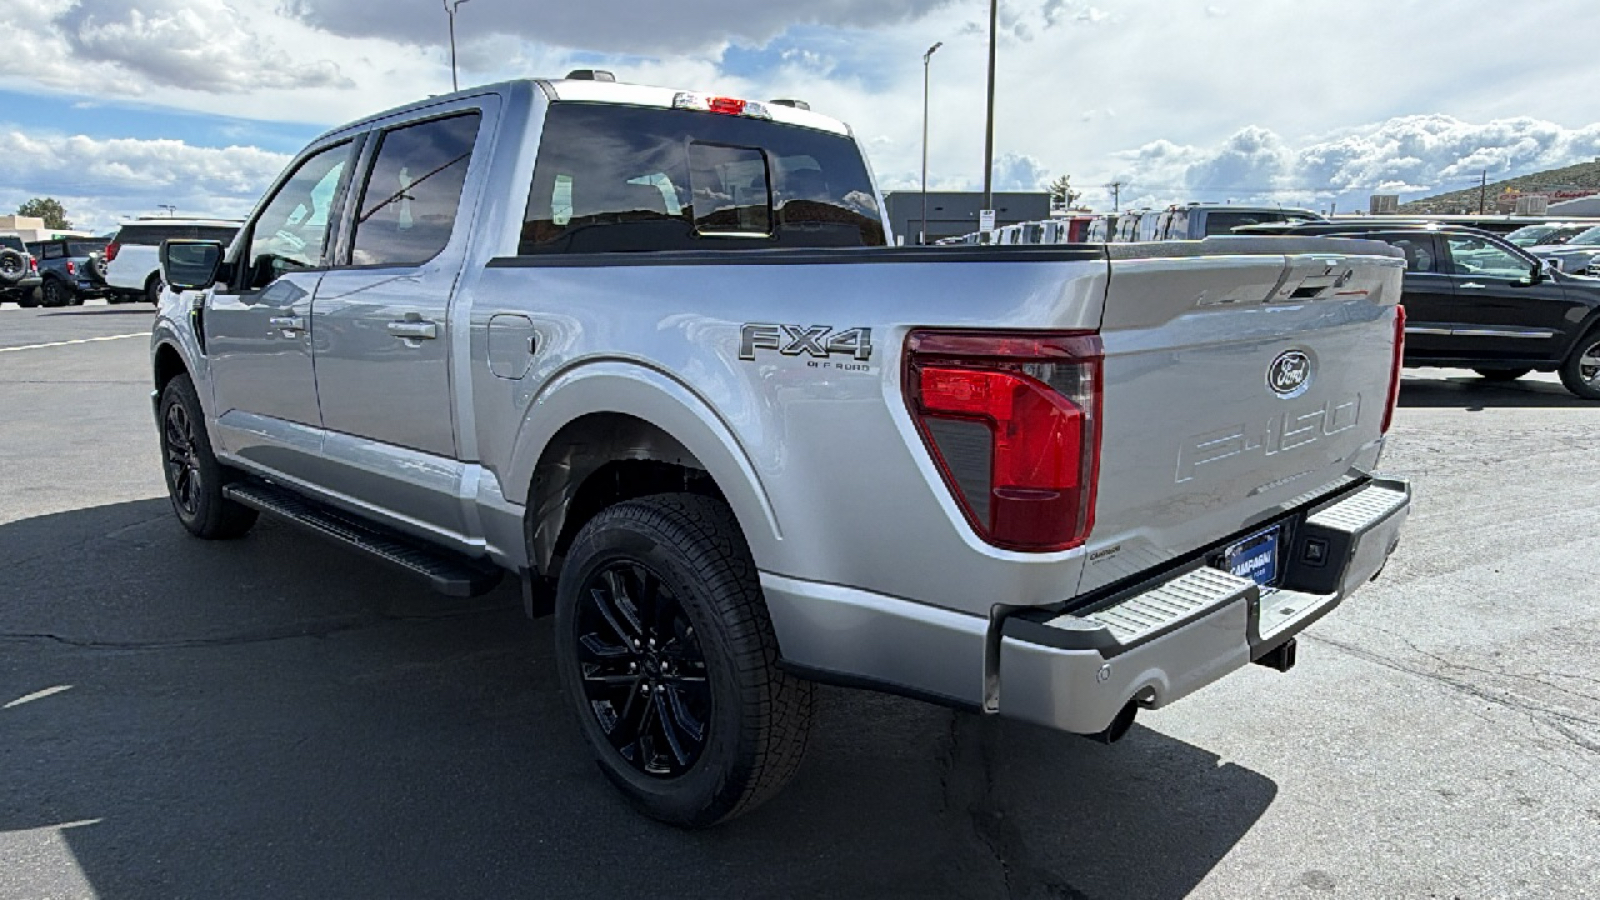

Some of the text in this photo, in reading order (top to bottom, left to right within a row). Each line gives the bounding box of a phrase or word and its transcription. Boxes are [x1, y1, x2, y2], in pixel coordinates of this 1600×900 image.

[738, 322, 873, 361] FX4
[836, 363, 870, 371] ROAD
[1276, 355, 1306, 386] Ford
